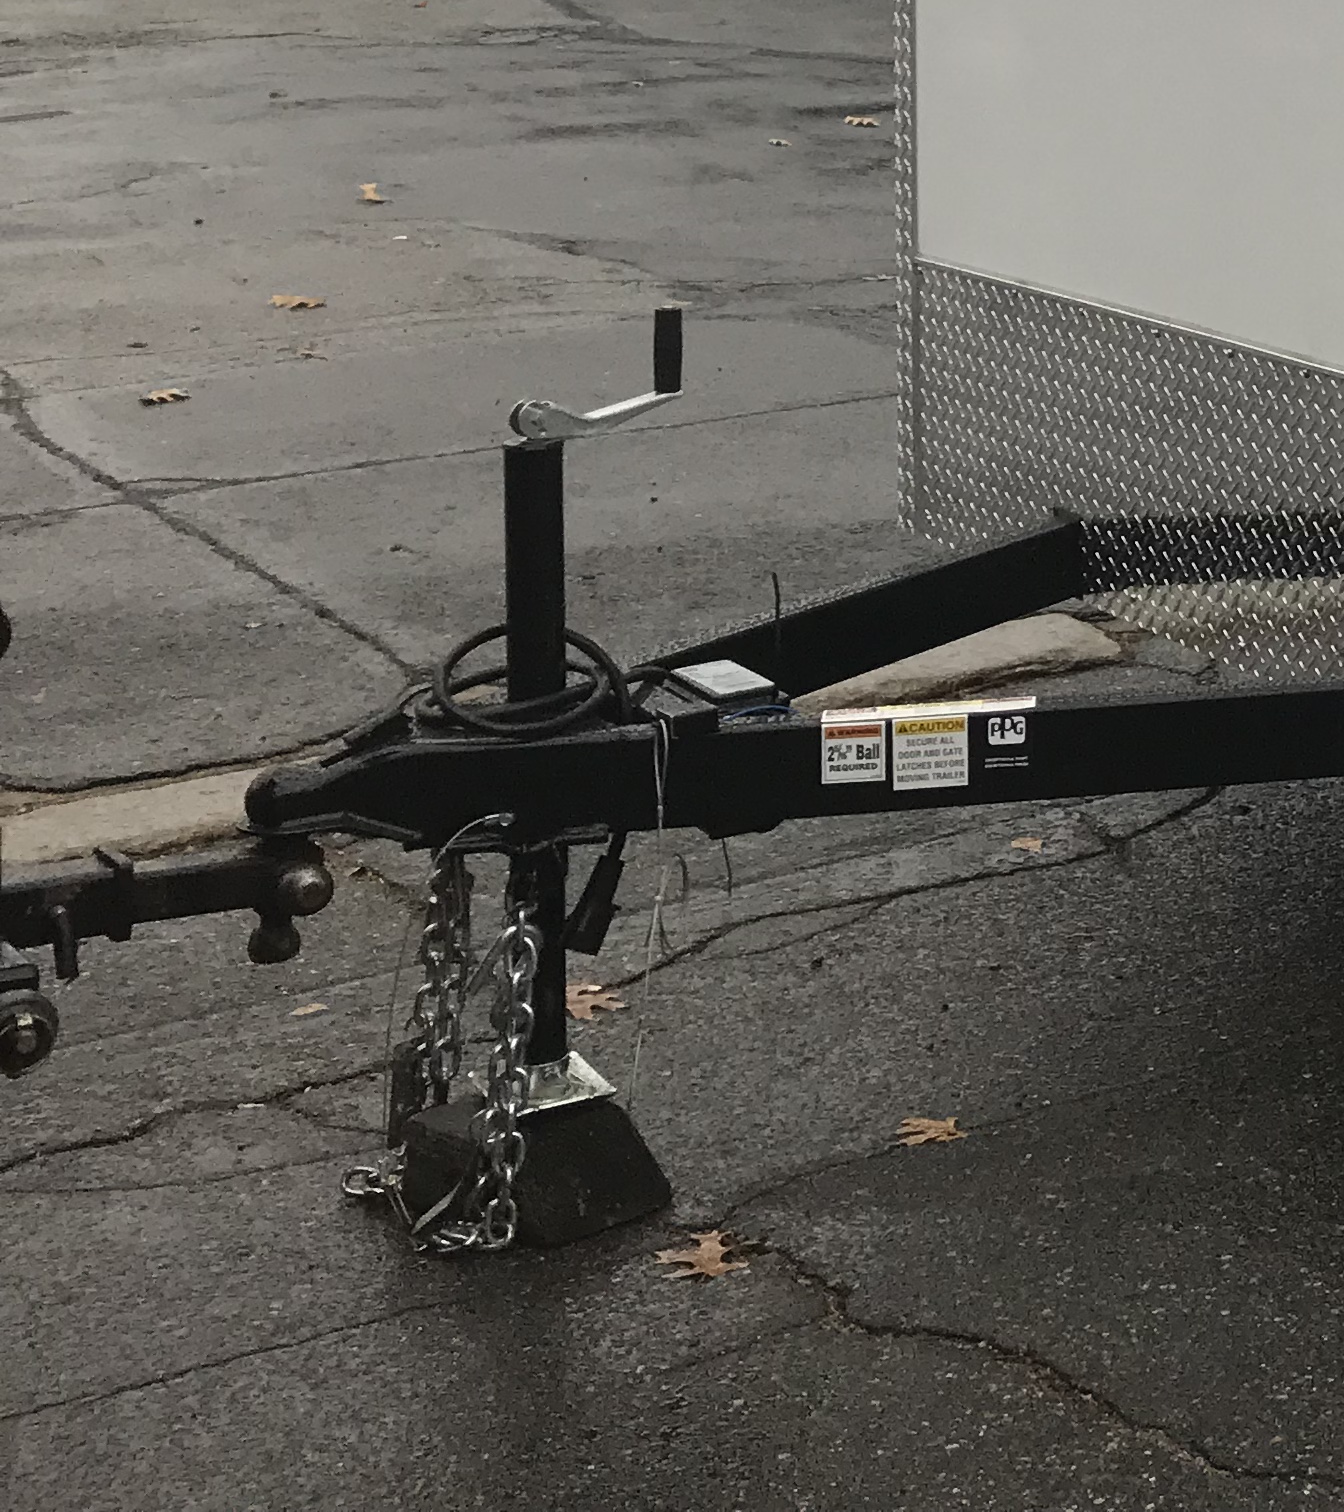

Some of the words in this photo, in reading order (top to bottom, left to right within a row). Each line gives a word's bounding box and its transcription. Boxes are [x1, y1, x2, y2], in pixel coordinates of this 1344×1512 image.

[909, 719, 965, 733] CAUTION
[906, 736, 938, 748] SECURE
[940, 736, 955, 745] ALL
[856, 742, 880, 761] Ball
[898, 749, 922, 760] DOOR
[923, 748, 940, 758] AND
[942, 747, 963, 757] GATE
[829, 762, 878, 773] REQUIRED
[896, 761, 932, 772] LATCHES
[934, 758, 965, 769] BEFORE
[932, 770, 965, 780] TRAILER
